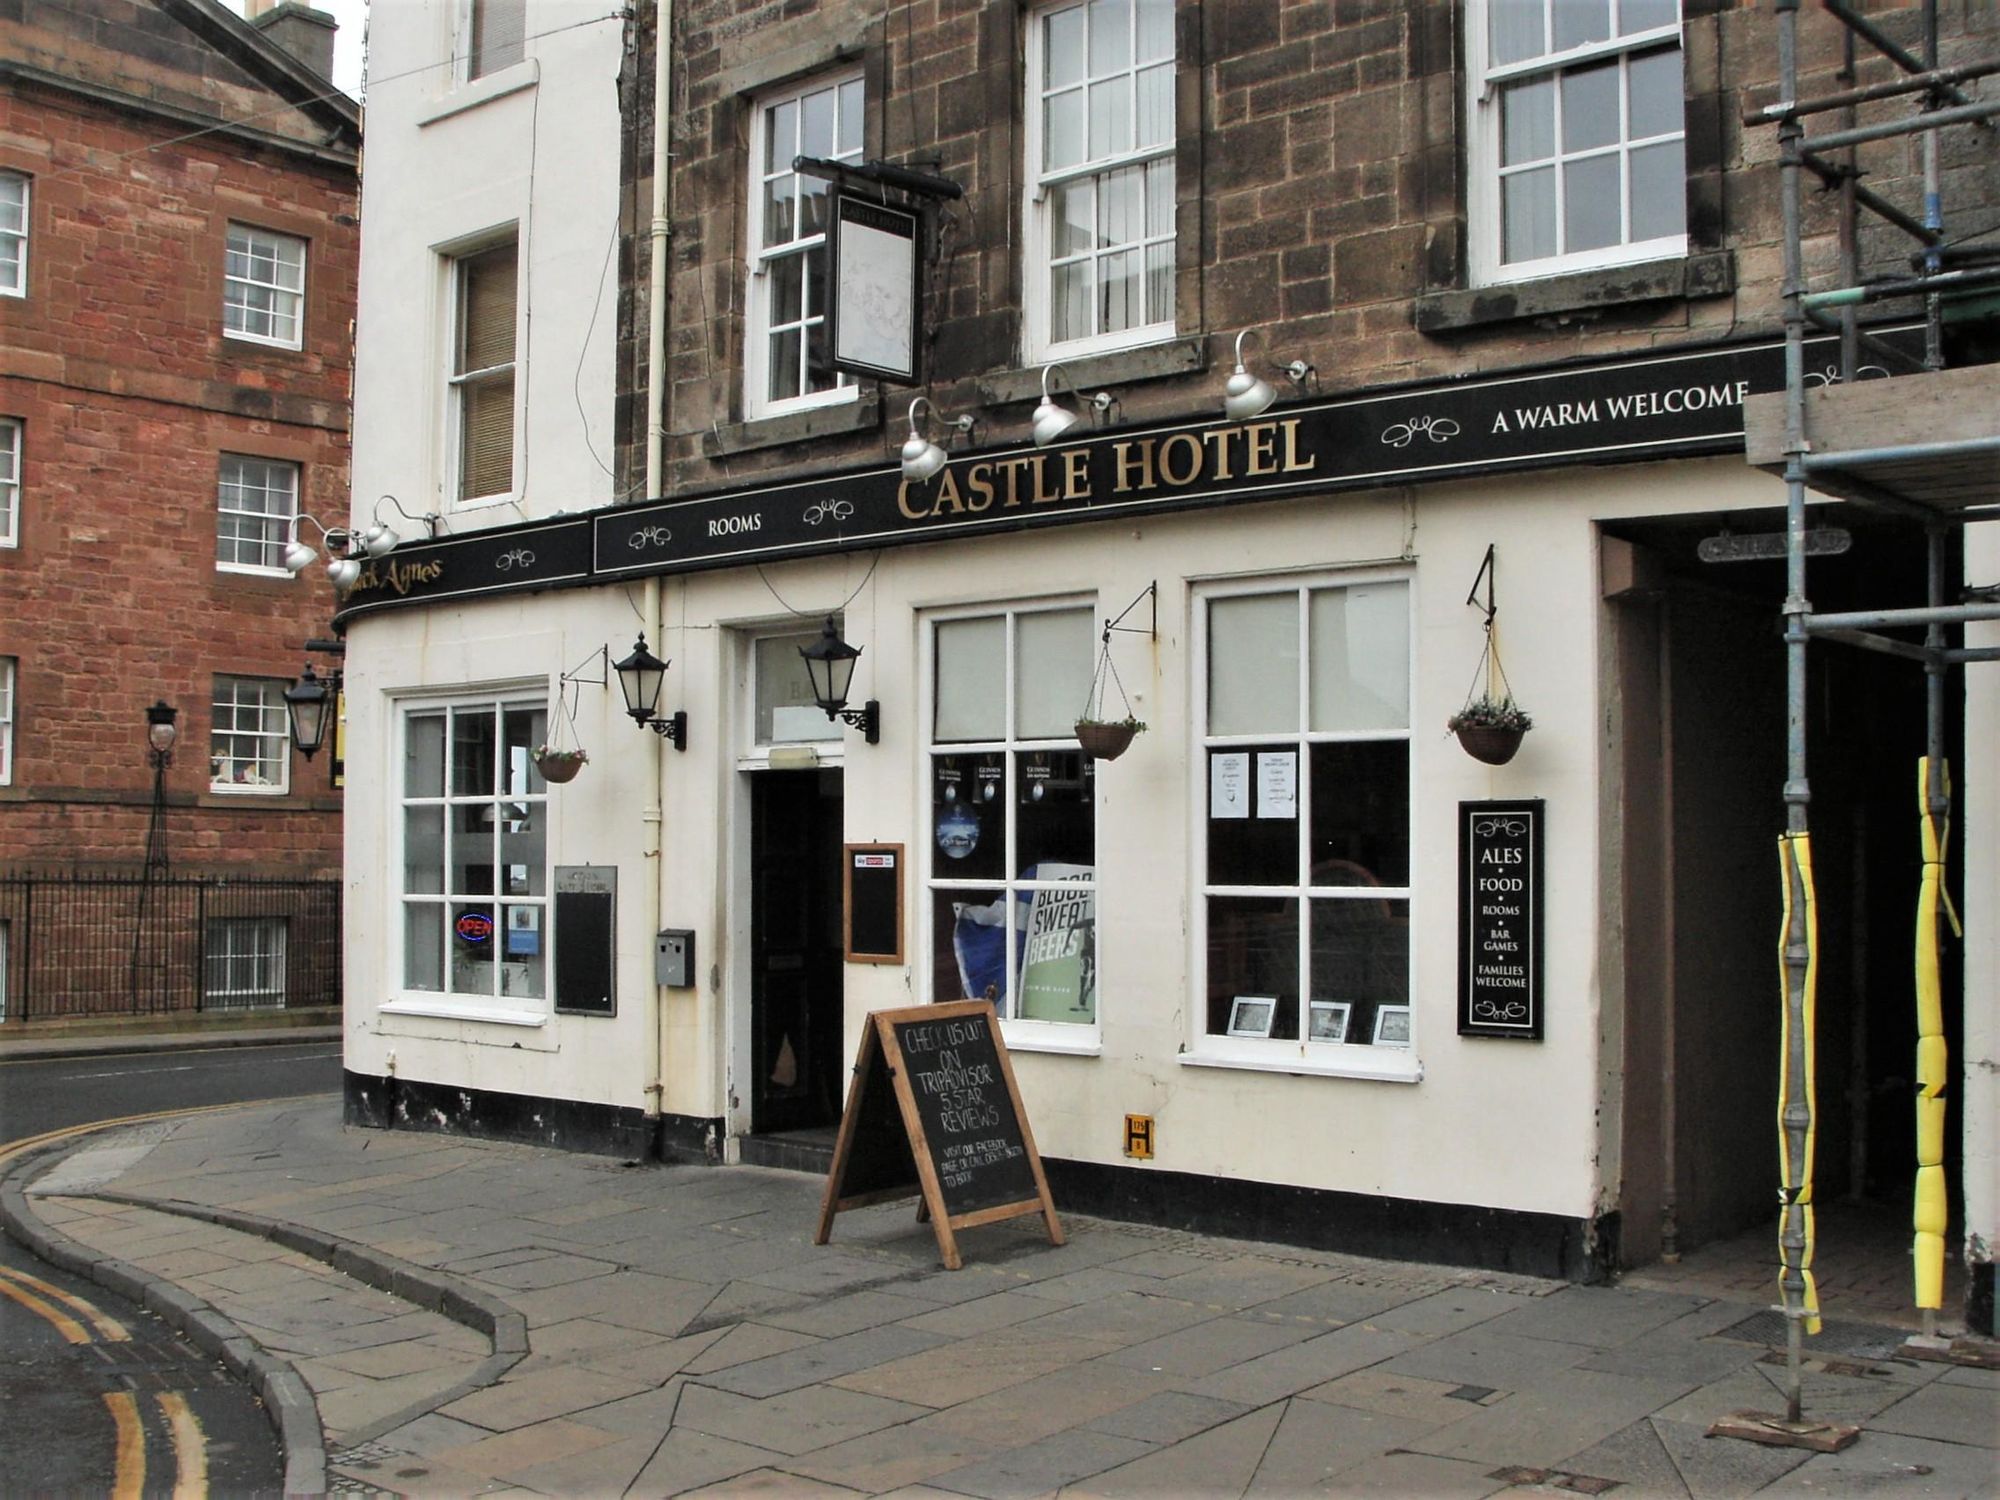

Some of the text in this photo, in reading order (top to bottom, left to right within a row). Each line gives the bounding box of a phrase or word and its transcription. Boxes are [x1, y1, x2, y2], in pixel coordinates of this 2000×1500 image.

[1491, 411, 1510, 434] A
[1515, 400, 1600, 431] WARM
[898, 419, 1315, 519] CASTLE HOTEL
[708, 513, 762, 537] ROOMS
[381, 559, 443, 595] Agnes
[1481, 848, 1522, 864] ALES
[1479, 878, 1523, 891] FOOD
[1034, 900, 1091, 936] SWEAT
[1482, 906, 1520, 915] ROOMS
[457, 919, 492, 936] OPEN
[1491, 929, 1510, 939] BAR
[1029, 930, 1079, 966] BEERS
[1484, 942, 1518, 951] GAMES
[1479, 965, 1523, 975] FAMILIES
[1476, 977, 1527, 988] WELCOME
[905, 1020, 984, 1054] CHECK US OUT
[940, 1049, 962, 1071] ON
[916, 1063, 994, 1094] TRIPADVISOR
[940, 1087, 986, 1111] 5 STAR
[940, 1105, 1000, 1132] REVIEWS
[1127, 1117, 1150, 1154] H
[944, 1175, 956, 1188] TO
